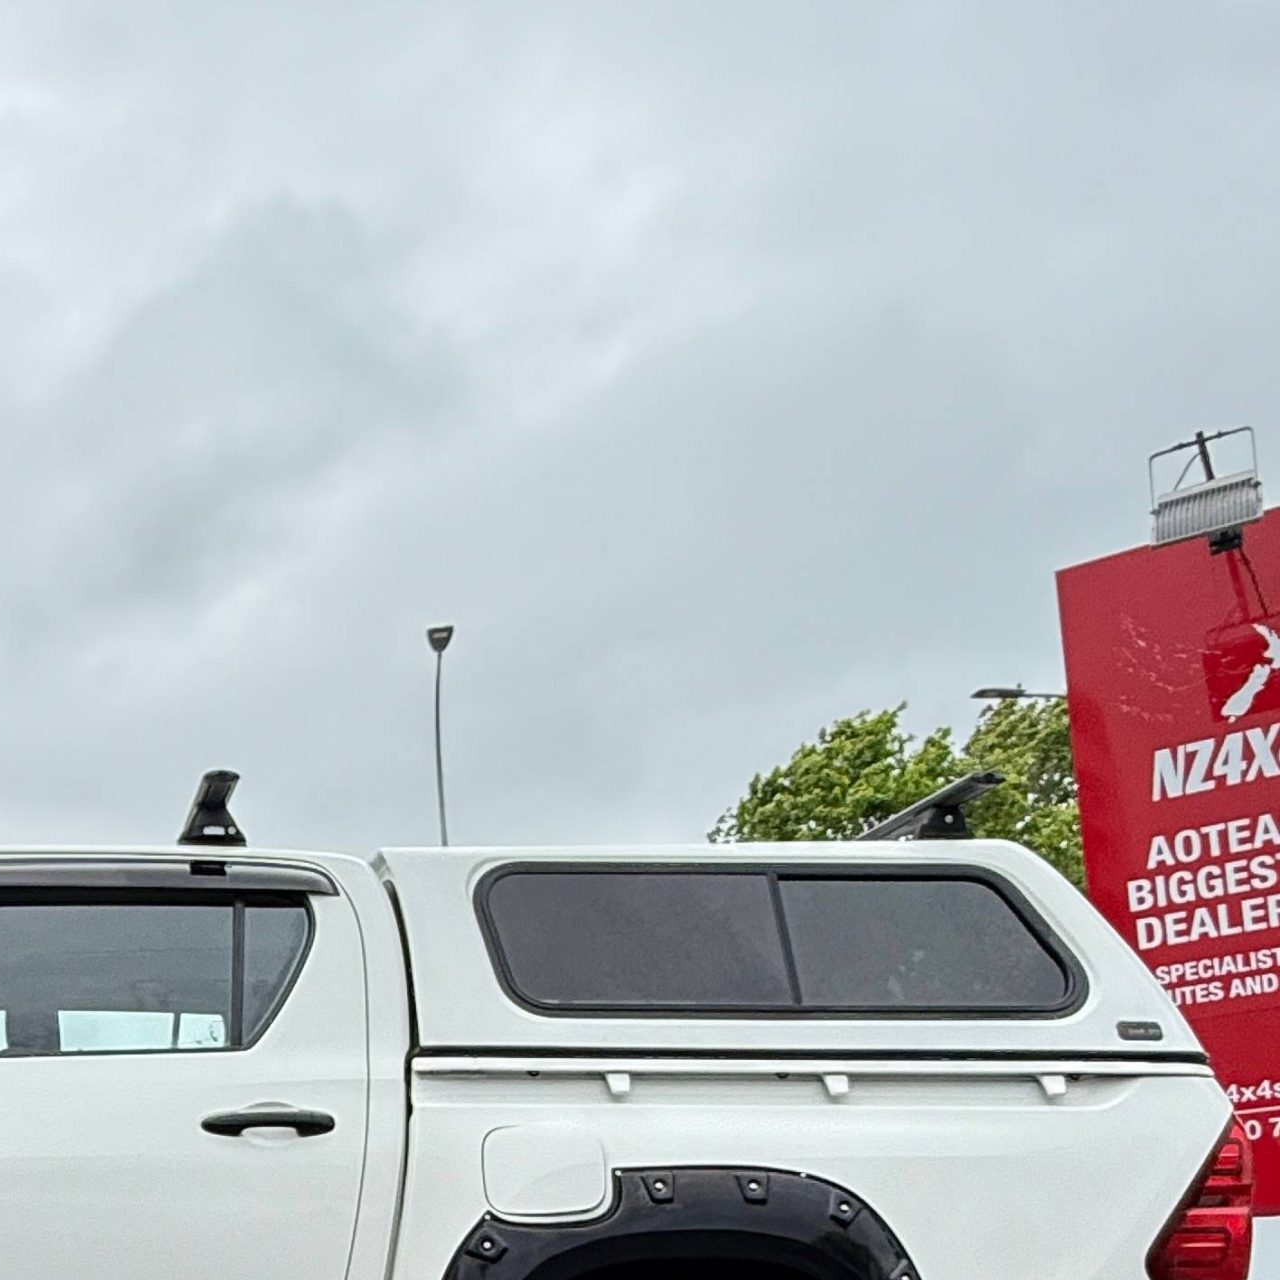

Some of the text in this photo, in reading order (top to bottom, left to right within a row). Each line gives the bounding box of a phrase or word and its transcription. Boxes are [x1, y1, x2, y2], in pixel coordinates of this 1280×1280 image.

[1152, 722, 1280, 802] NZ4X
[1146, 813, 1280, 870] AOTEA
[1127, 852, 1280, 913] BIGGES
[1229, 973, 1279, 999] AND
